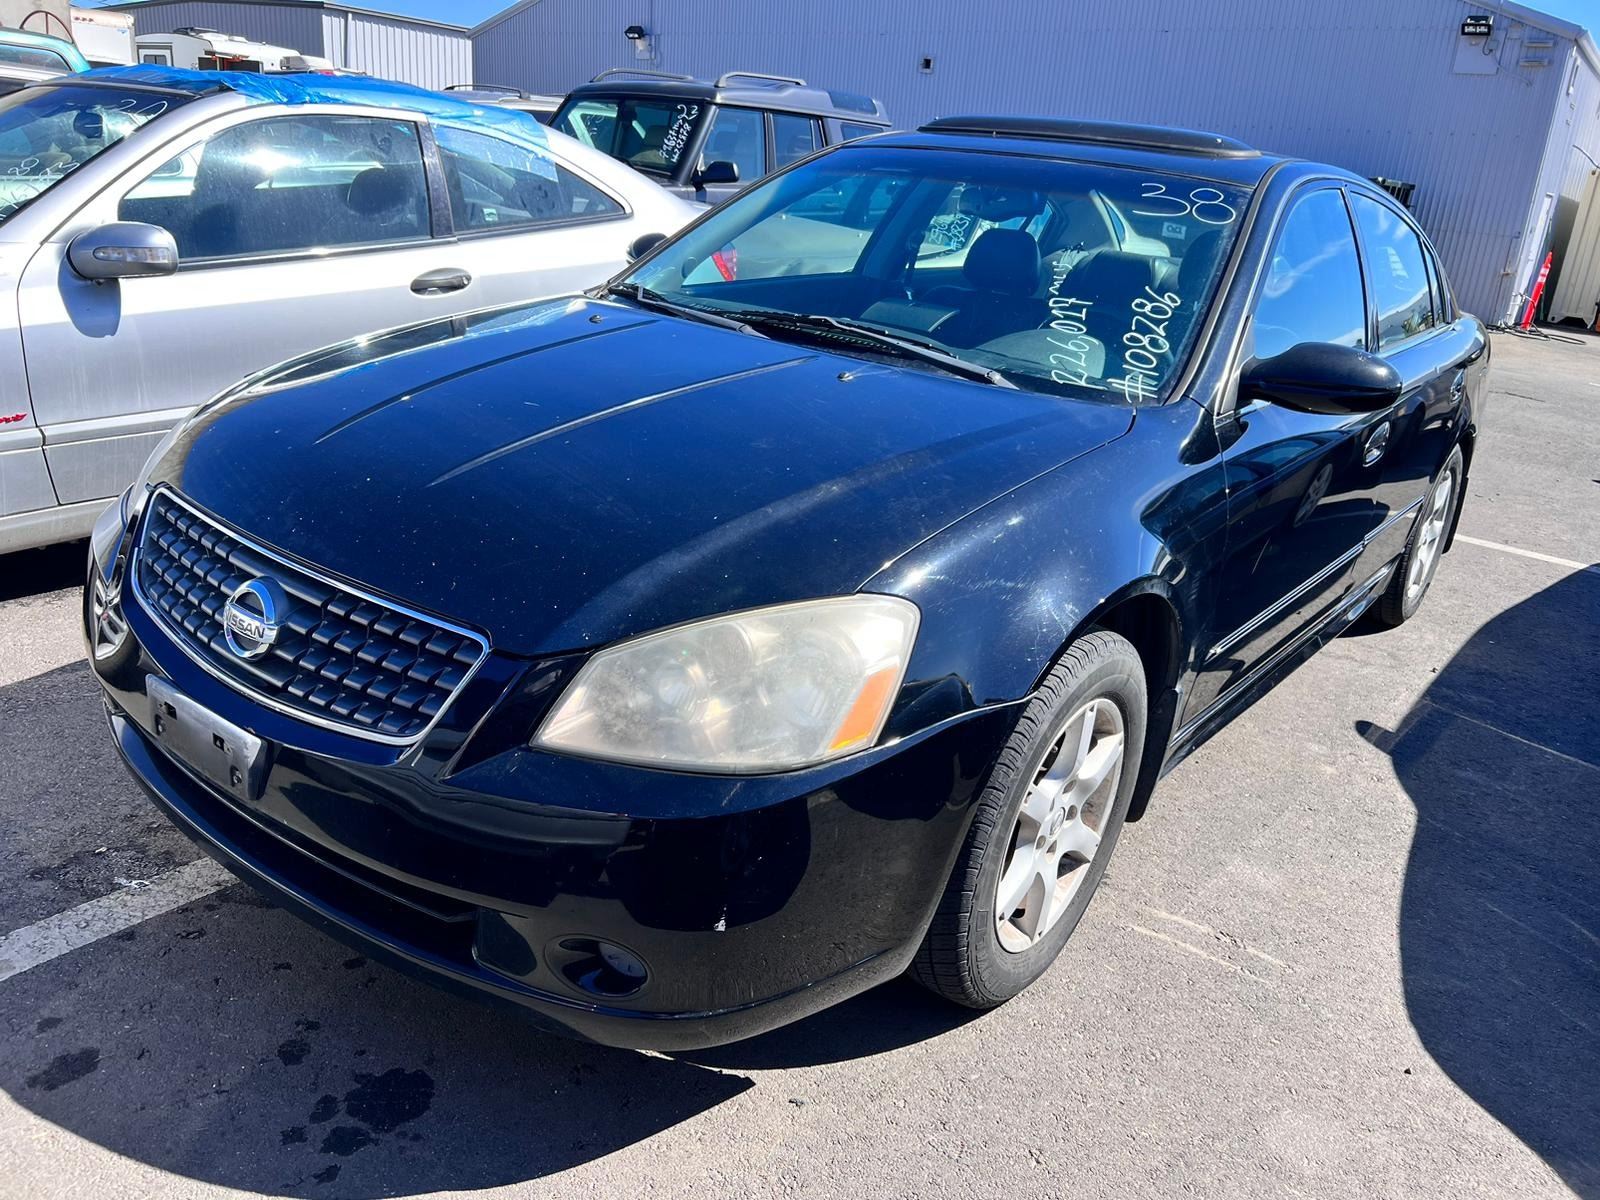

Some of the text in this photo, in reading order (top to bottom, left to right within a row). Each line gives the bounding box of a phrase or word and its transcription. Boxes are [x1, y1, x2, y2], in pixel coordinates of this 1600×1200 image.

[1132, 183, 1236, 224] 38
[1106, 285, 1182, 403] #108286
[225, 607, 265, 638] NISSAN
